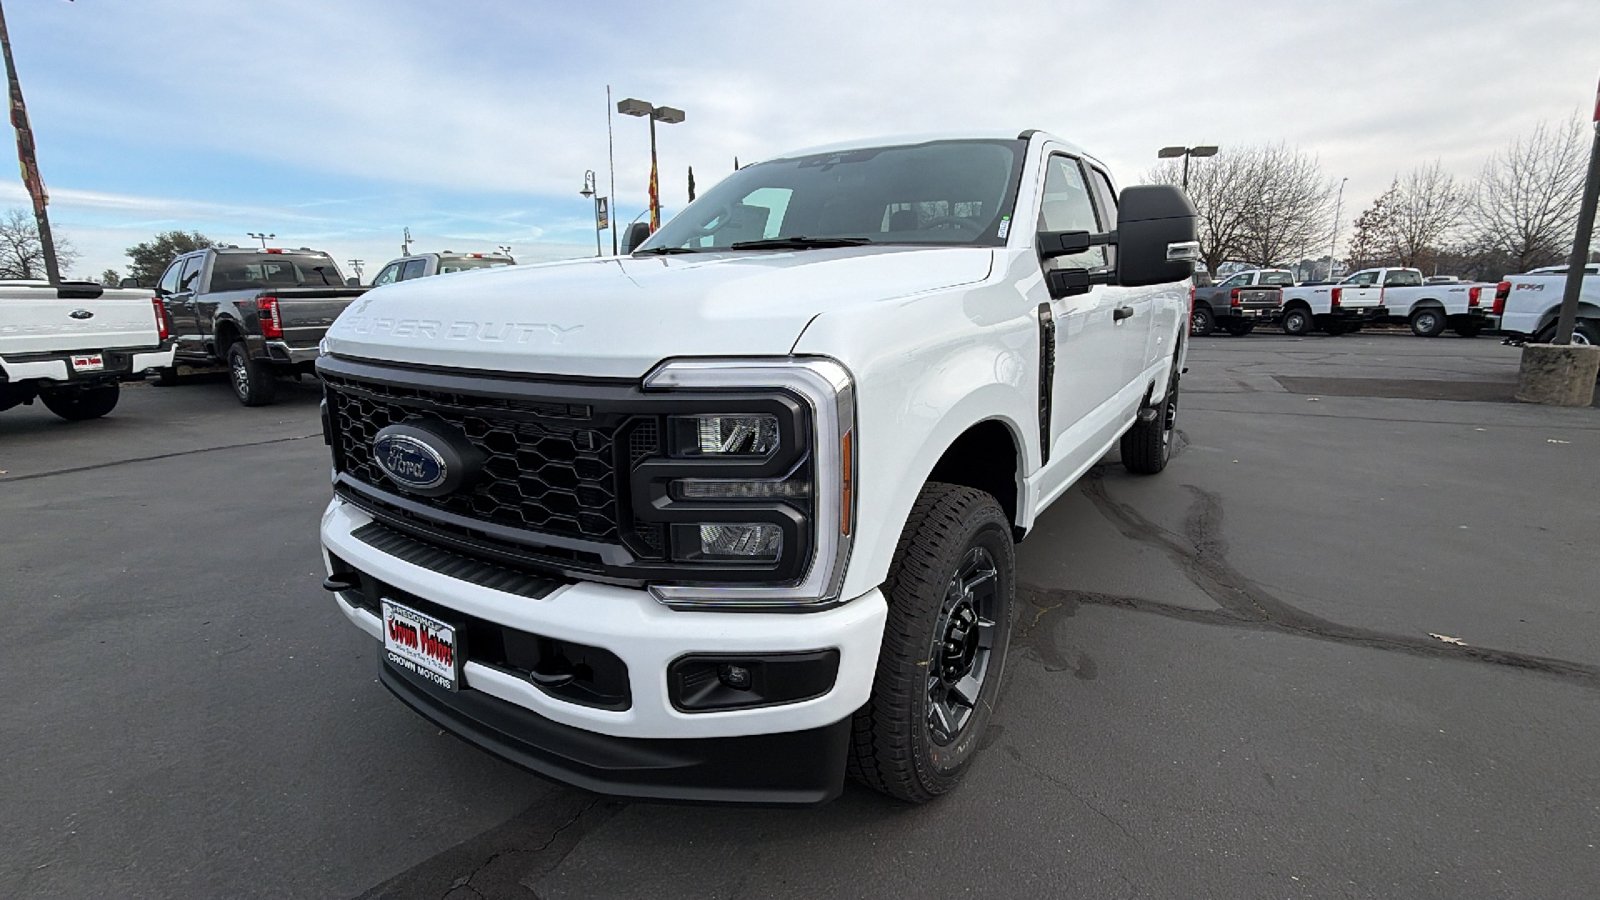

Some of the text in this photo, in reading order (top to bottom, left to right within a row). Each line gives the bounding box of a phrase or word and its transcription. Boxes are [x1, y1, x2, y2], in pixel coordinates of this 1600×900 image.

[340, 316, 585, 345] SUPER DUTY
[386, 445, 426, 478] Ford
[388, 652, 416, 672] CROWN
[417, 666, 451, 689] MOTORS
